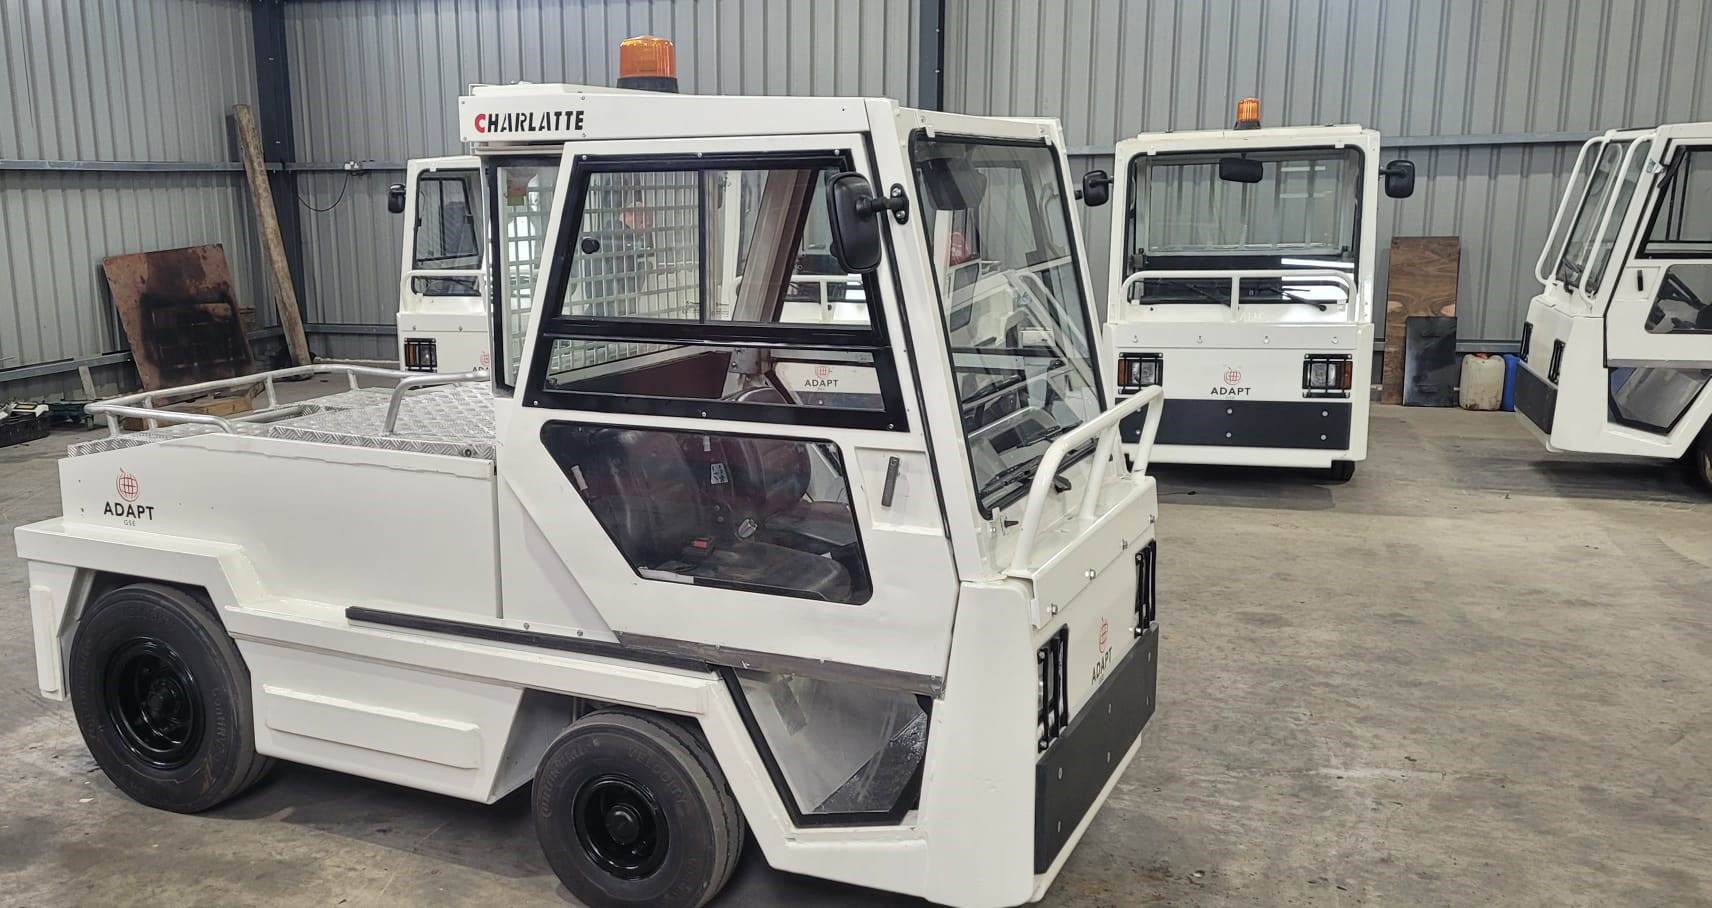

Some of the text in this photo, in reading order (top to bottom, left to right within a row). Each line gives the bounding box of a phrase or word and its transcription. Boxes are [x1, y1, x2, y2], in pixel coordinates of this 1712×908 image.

[474, 110, 585, 134] CHARLATTE
[804, 379, 839, 388] ADAPT
[1210, 386, 1252, 396] ADAPT
[103, 500, 155, 521] ADAPT
[1091, 646, 1113, 685] ADAPT
